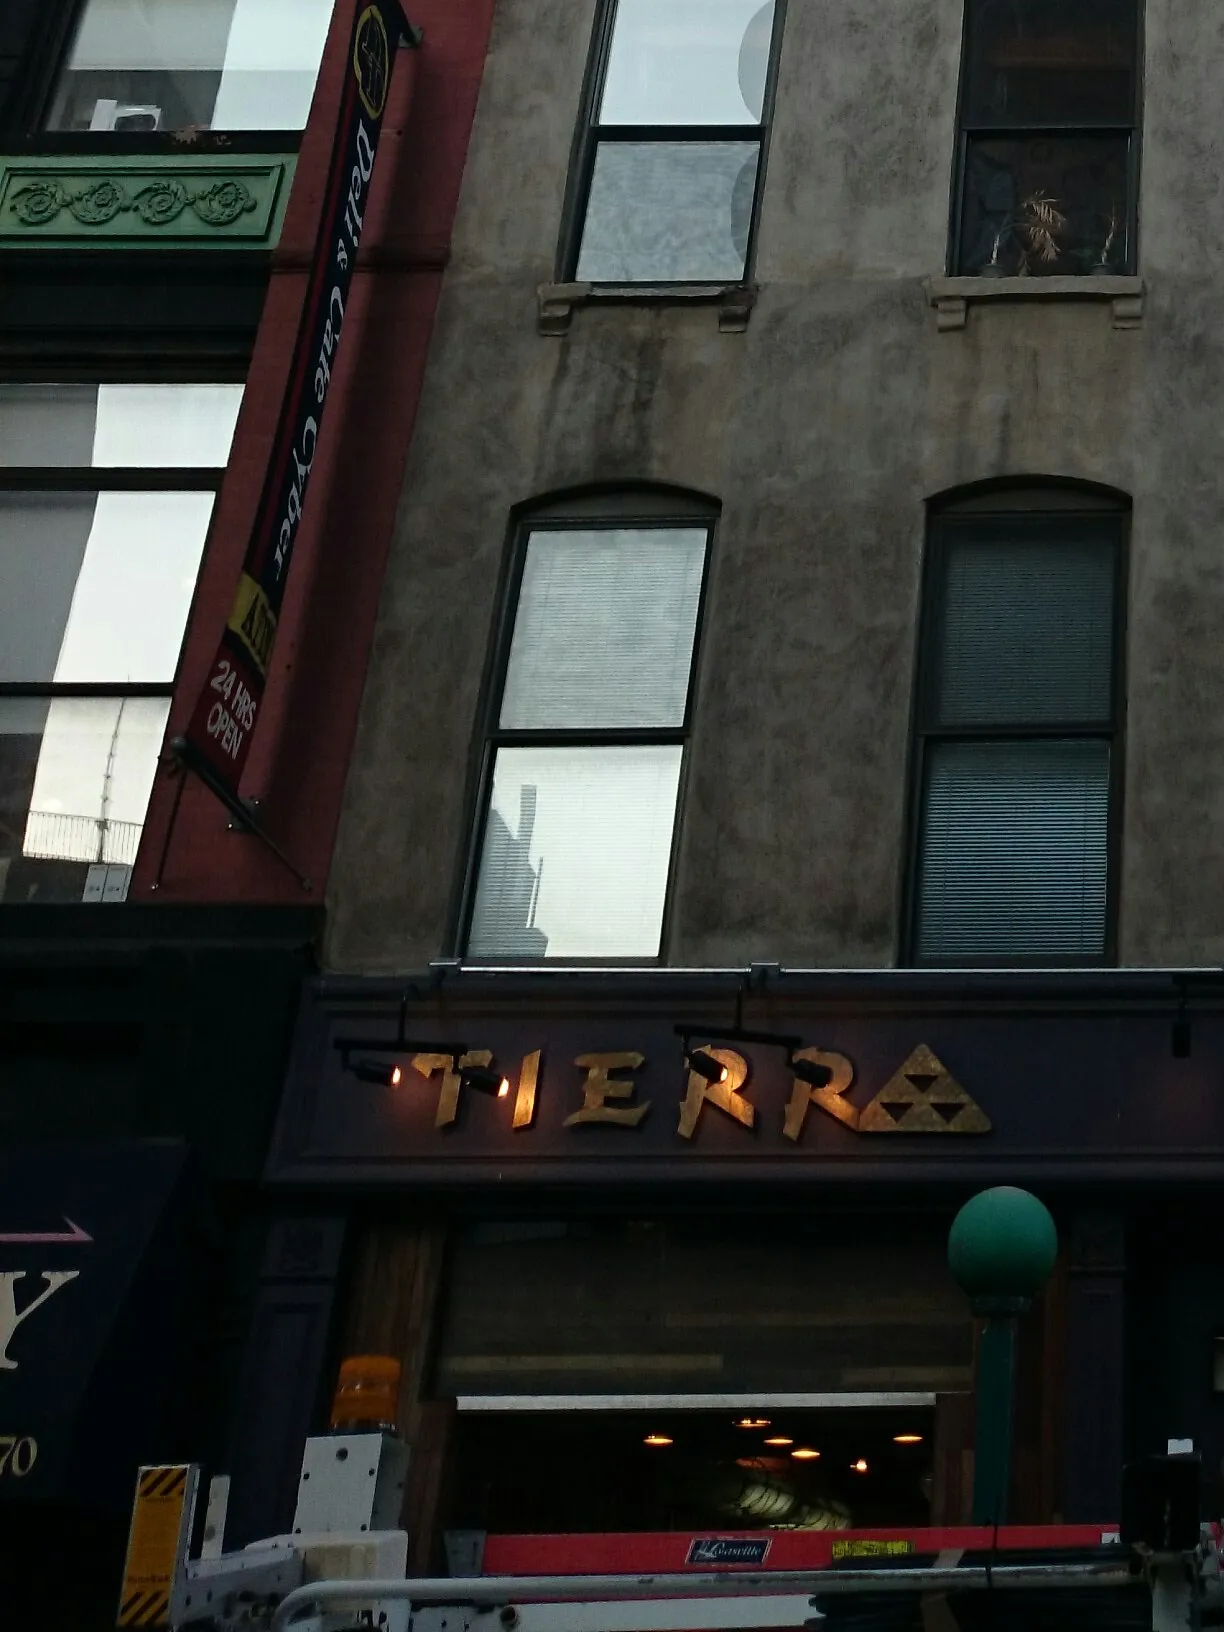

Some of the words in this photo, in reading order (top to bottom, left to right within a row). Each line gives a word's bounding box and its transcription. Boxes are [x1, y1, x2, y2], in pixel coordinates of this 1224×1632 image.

[343, 117, 375, 248] Deli
[314, 285, 344, 404] Cafe
[274, 415, 318, 582] Cyber
[206, 700, 244, 761] OPEN
[210, 659, 237, 701] 24
[231, 681, 257, 731] HRS
[411, 1042, 993, 1142] TIERRA
